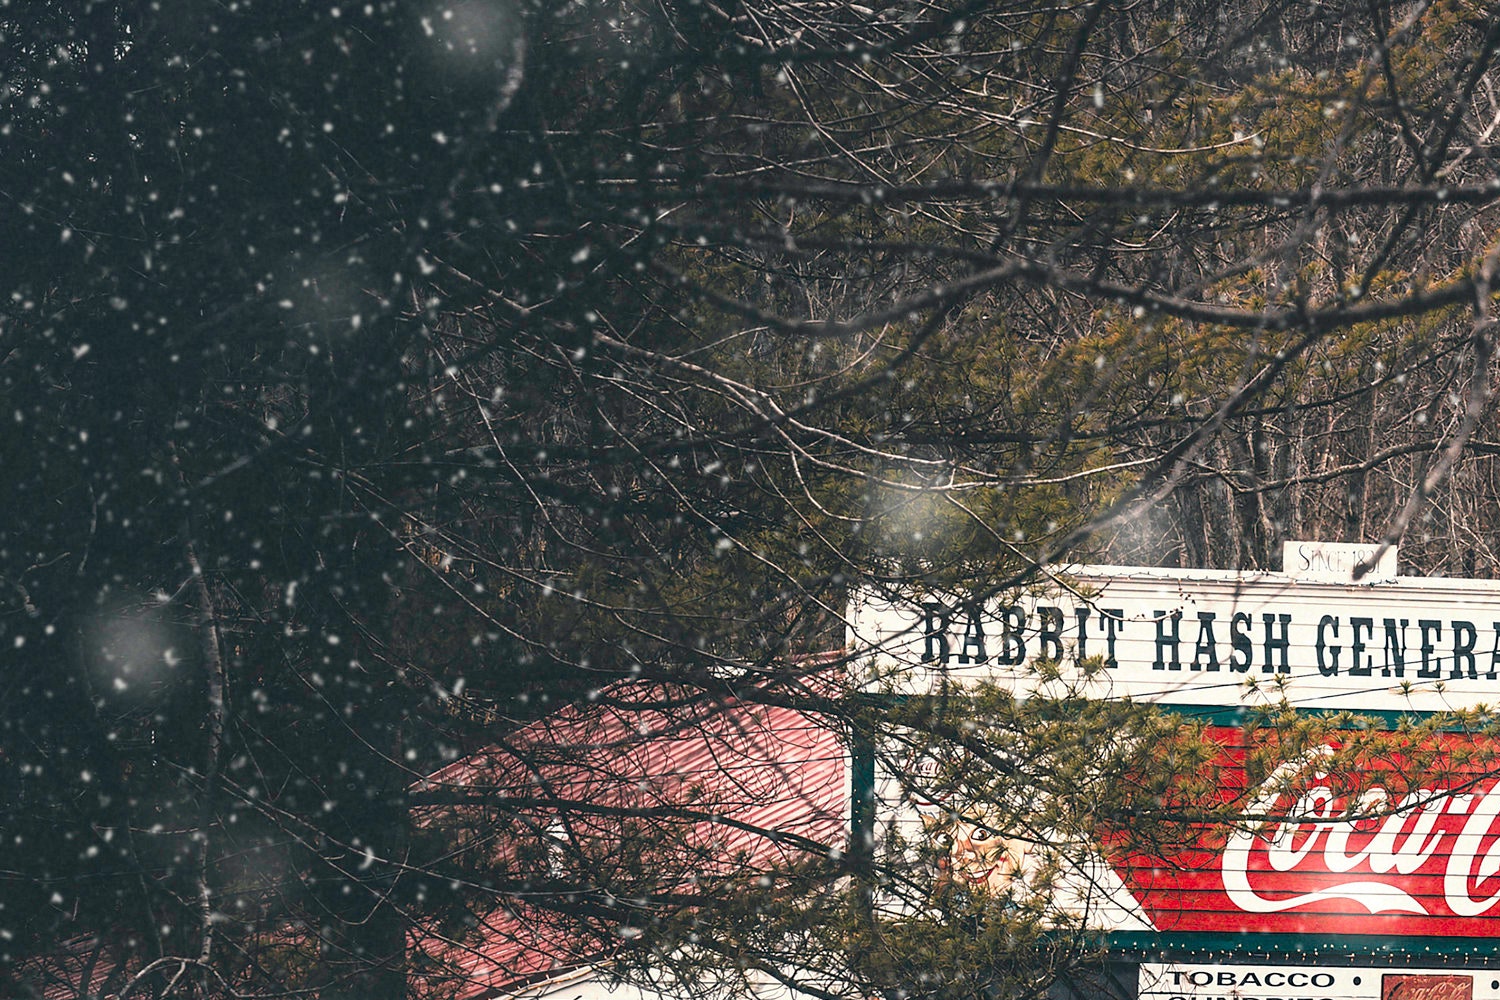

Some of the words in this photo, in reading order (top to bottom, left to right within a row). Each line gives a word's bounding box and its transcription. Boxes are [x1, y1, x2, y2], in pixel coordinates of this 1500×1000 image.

[920, 601, 1124, 669] RABBIT
[1152, 609, 1291, 674] HASH
[1167, 970, 1336, 988] TOBACCO
